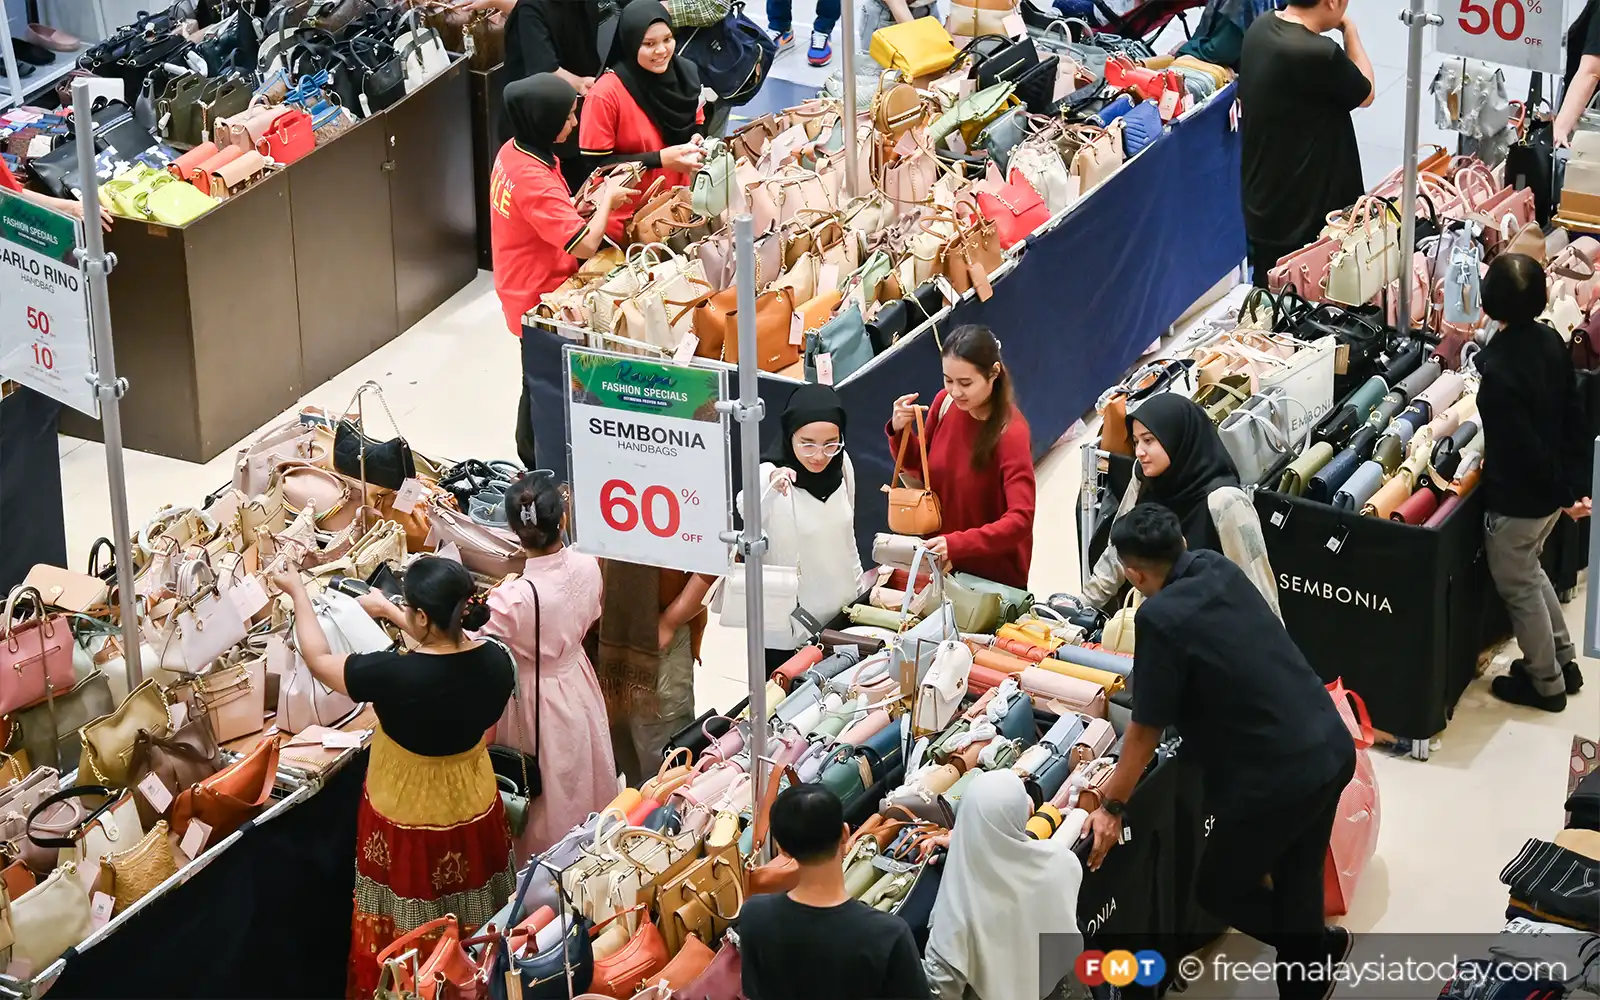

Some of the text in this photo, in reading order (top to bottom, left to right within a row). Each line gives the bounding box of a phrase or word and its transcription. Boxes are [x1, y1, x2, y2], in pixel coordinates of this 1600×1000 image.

[1524, 36, 1542, 46] OFF
[2, 215, 29, 233] FASHION
[29, 225, 59, 245] SPECIALS
[20, 273, 55, 294] HANDBAG
[43, 264, 79, 292] RINO
[612, 360, 678, 389] Raya
[602, 381, 688, 402] FASHION SPECIALS
[1291, 398, 1333, 431] EMBONI
[589, 417, 706, 450] SEMBONIA
[617, 440, 678, 457] HANDBAGS
[681, 532, 703, 543] OFF
[1279, 573, 1393, 614] SEMBONIA
[1087, 896, 1117, 937] ONIA
